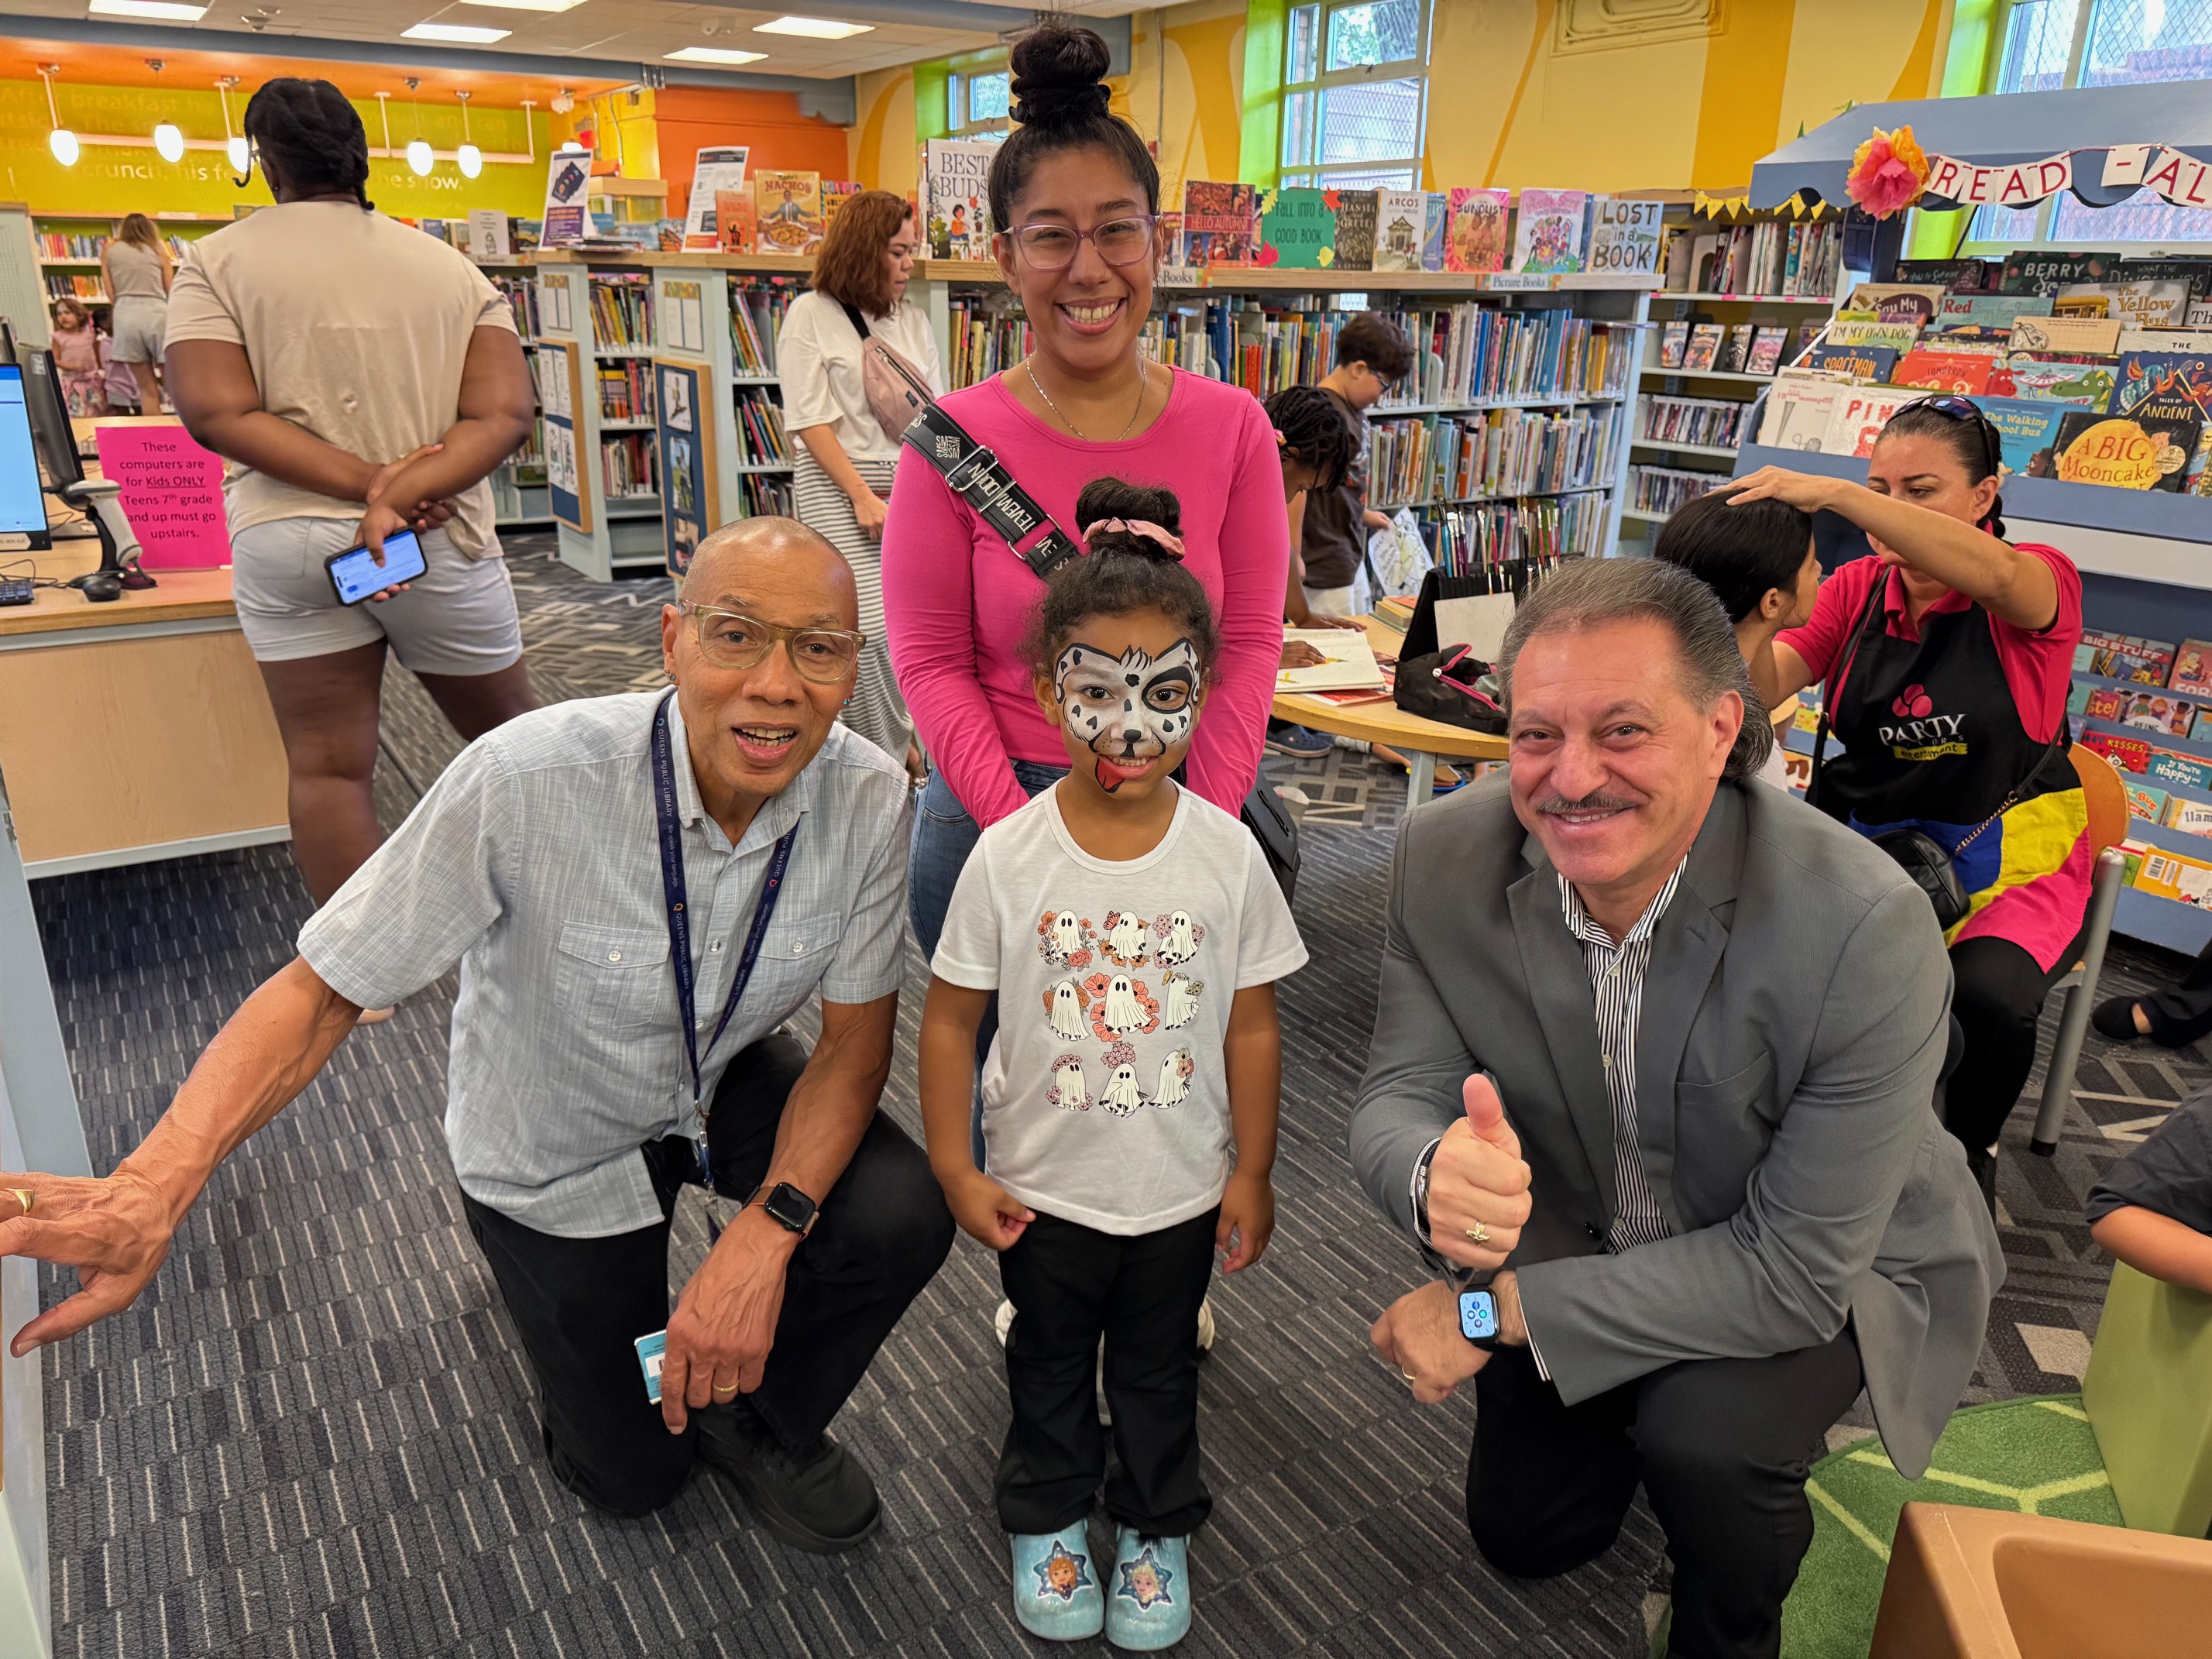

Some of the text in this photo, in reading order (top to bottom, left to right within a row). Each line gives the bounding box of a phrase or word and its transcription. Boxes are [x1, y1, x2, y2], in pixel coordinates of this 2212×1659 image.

[940, 153, 989, 177] BEST
[407, 175, 464, 191] snow.
[765, 180, 812, 194] NACHOS
[939, 176, 988, 199] BUDS
[1932, 161, 2067, 201] READ
[1457, 204, 1504, 215] SUNDUST
[1602, 201, 1658, 225] LOST
[1191, 218, 1214, 229] HELLO
[1275, 228, 1323, 244] GOOD BOOK
[1613, 227, 1637, 242] in a
[1593, 243, 1653, 270] BOOK
[2024, 263, 2085, 277] BERRY
[2138, 264, 2178, 273] WHAT THE
[1164, 271, 1194, 284] Books
[1493, 276, 1546, 288] Picture Books
[2118, 287, 2139, 296] The
[1901, 297, 1918, 314] My
[1943, 299, 1973, 314] Red
[2118, 296, 2176, 312] Yellow
[2135, 312, 2169, 325] Bus
[1849, 326, 1864, 338] MY
[1865, 326, 1888, 339] OWN
[1890, 328, 1911, 340] DOG
[1823, 356, 1877, 379] SPACEMAN
[1927, 366, 1967, 377] TOMORROW
[2139, 403, 2194, 421] ANCIENT
[1984, 411, 2004, 422] The
[2007, 414, 2049, 430] Walking
[1996, 424, 2042, 437] hool Bus
[142, 441, 177, 452] These
[2076, 438, 2091, 455] A
[2094, 435, 2151, 462] BIG
[120, 460, 204, 472] computers are
[2061, 455, 2155, 483] Mooncake
[125, 476, 204, 487] for Kids ONLY
[124, 493, 213, 507] Teens 7th grade
[127, 512, 217, 525] and up must go
[150, 528, 200, 541] upstairs.
[2083, 635, 2163, 661] BIG STUFF
[1878, 714, 1966, 746] PARTY
[2107, 738, 2145, 753] KISSES
[658, 728, 667, 758] QUEENS
[663, 787, 673, 817] LIBRARY
[2155, 763, 2192, 785] Happy
[2136, 791, 2159, 812] Bus
[668, 834, 676, 850] speak
[774, 832, 791, 877] QUEENS PUBL
[676, 913, 685, 939] QUEENS
[678, 940, 687, 963] PUBLIC
